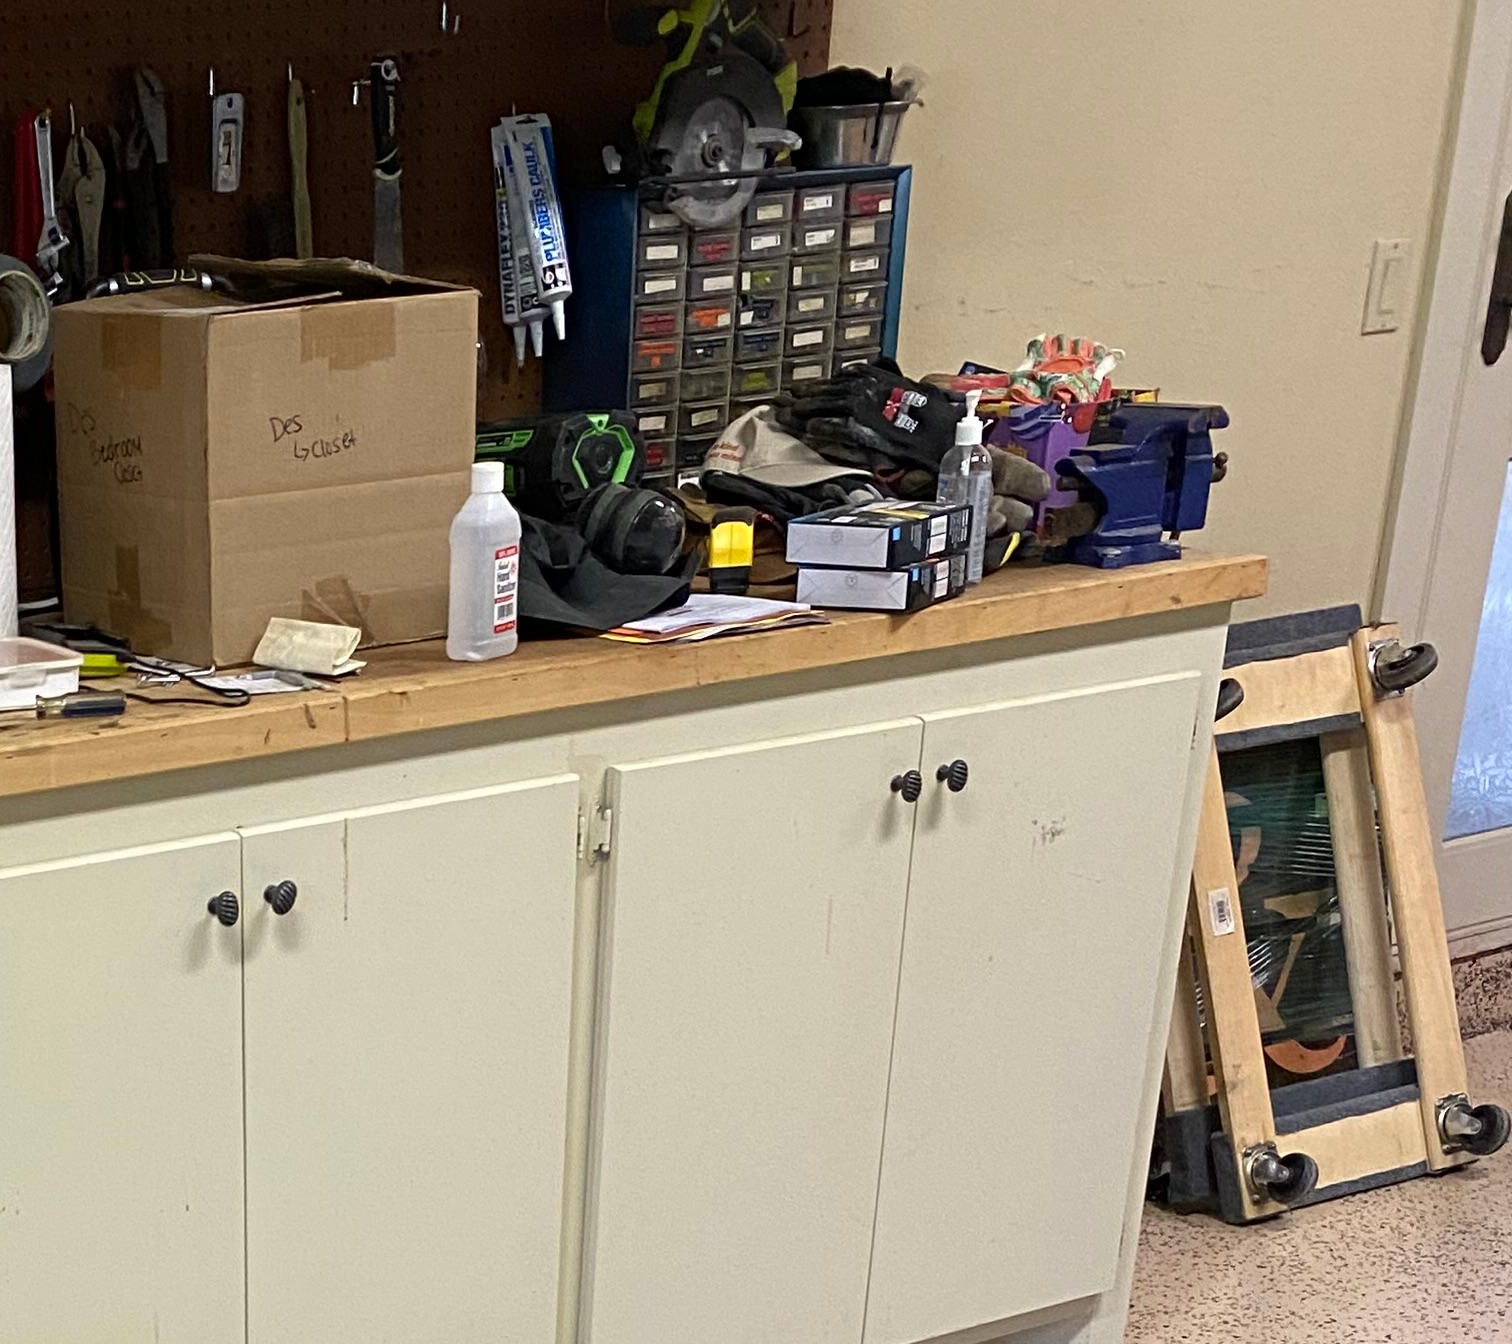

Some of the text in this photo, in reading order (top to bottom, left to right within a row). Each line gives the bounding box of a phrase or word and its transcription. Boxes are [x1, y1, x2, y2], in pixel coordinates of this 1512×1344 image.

[522, 142, 539, 187] CAULK
[269, 414, 303, 442] Des
[311, 430, 356, 458] Closet
